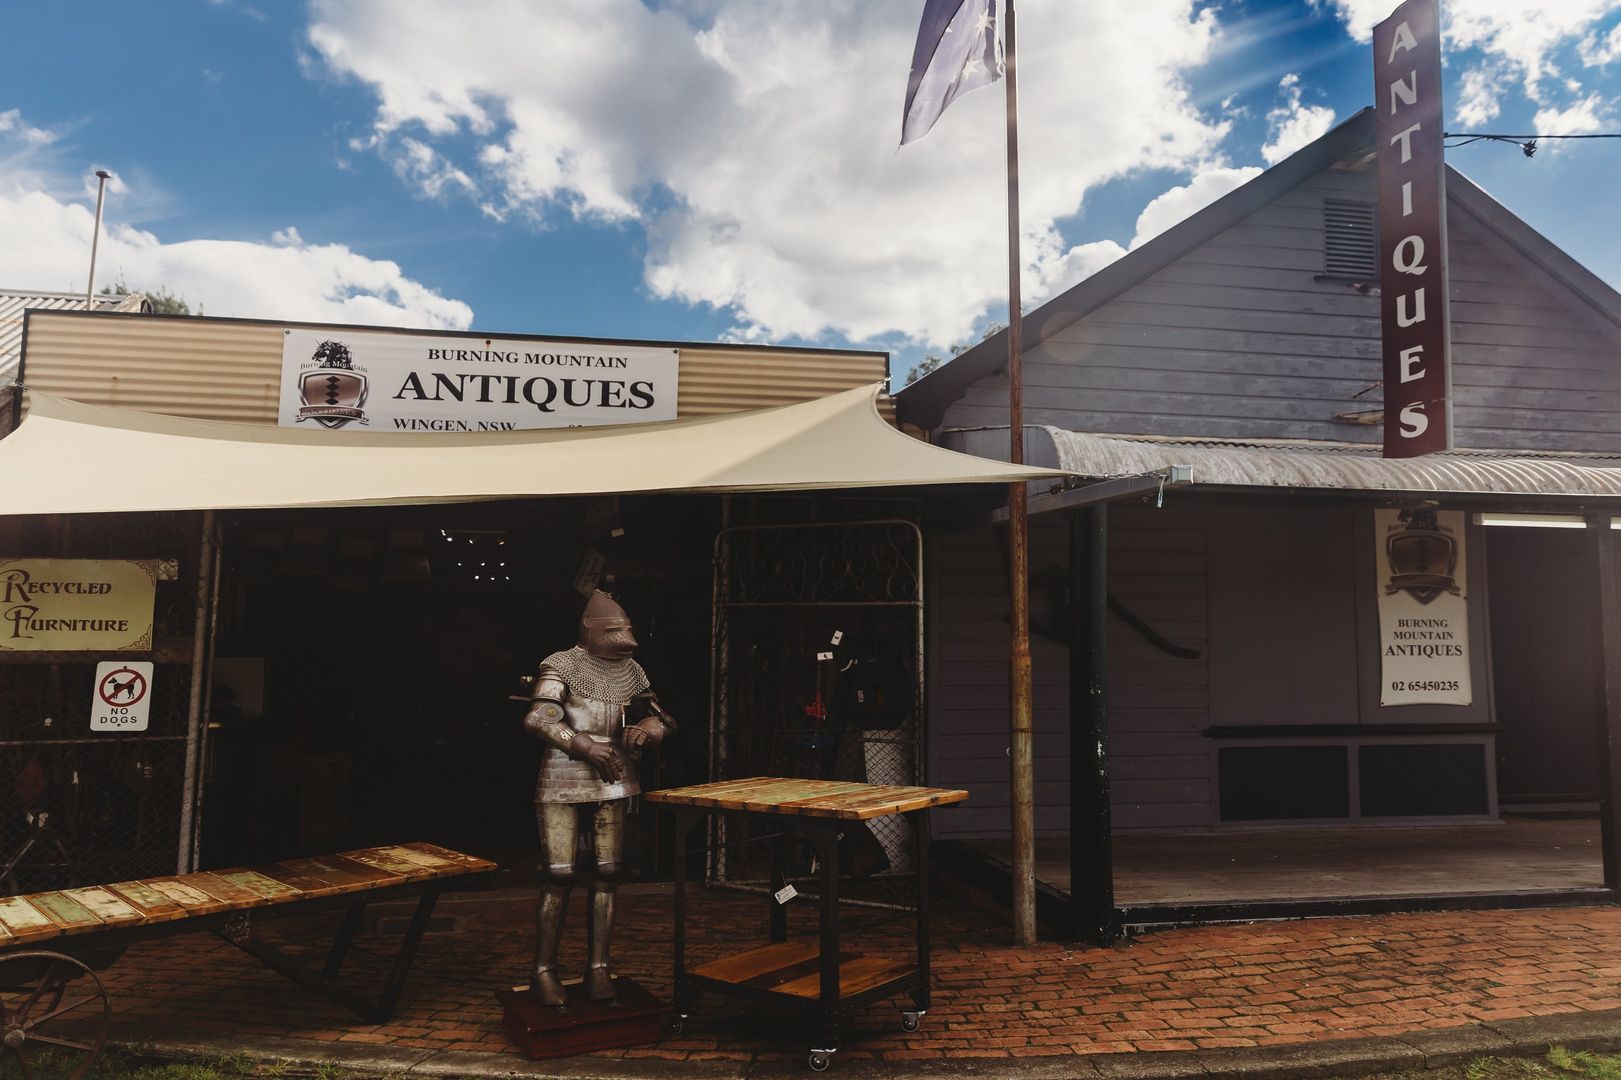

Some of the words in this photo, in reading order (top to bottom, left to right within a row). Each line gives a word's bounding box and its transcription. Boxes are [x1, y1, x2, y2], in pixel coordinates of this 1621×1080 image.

[1387, 20, 1429, 439] ANTIQUES
[428, 348, 519, 364] BURNING
[524, 353, 629, 369] MOUNTAIN
[392, 371, 655, 413] ANTIQUES
[478, 421, 517, 431] NSW
[4, 605, 129, 639] FURNITURE
[1398, 619, 1448, 629] BURNING
[1393, 631, 1454, 641] MOUNTAIN
[1385, 644, 1463, 659] ANTIQUES
[1391, 680, 1405, 692] 02
[1408, 680, 1460, 692] 65450235
[110, 707, 129, 716] NO
[100, 716, 138, 724] DOGS
